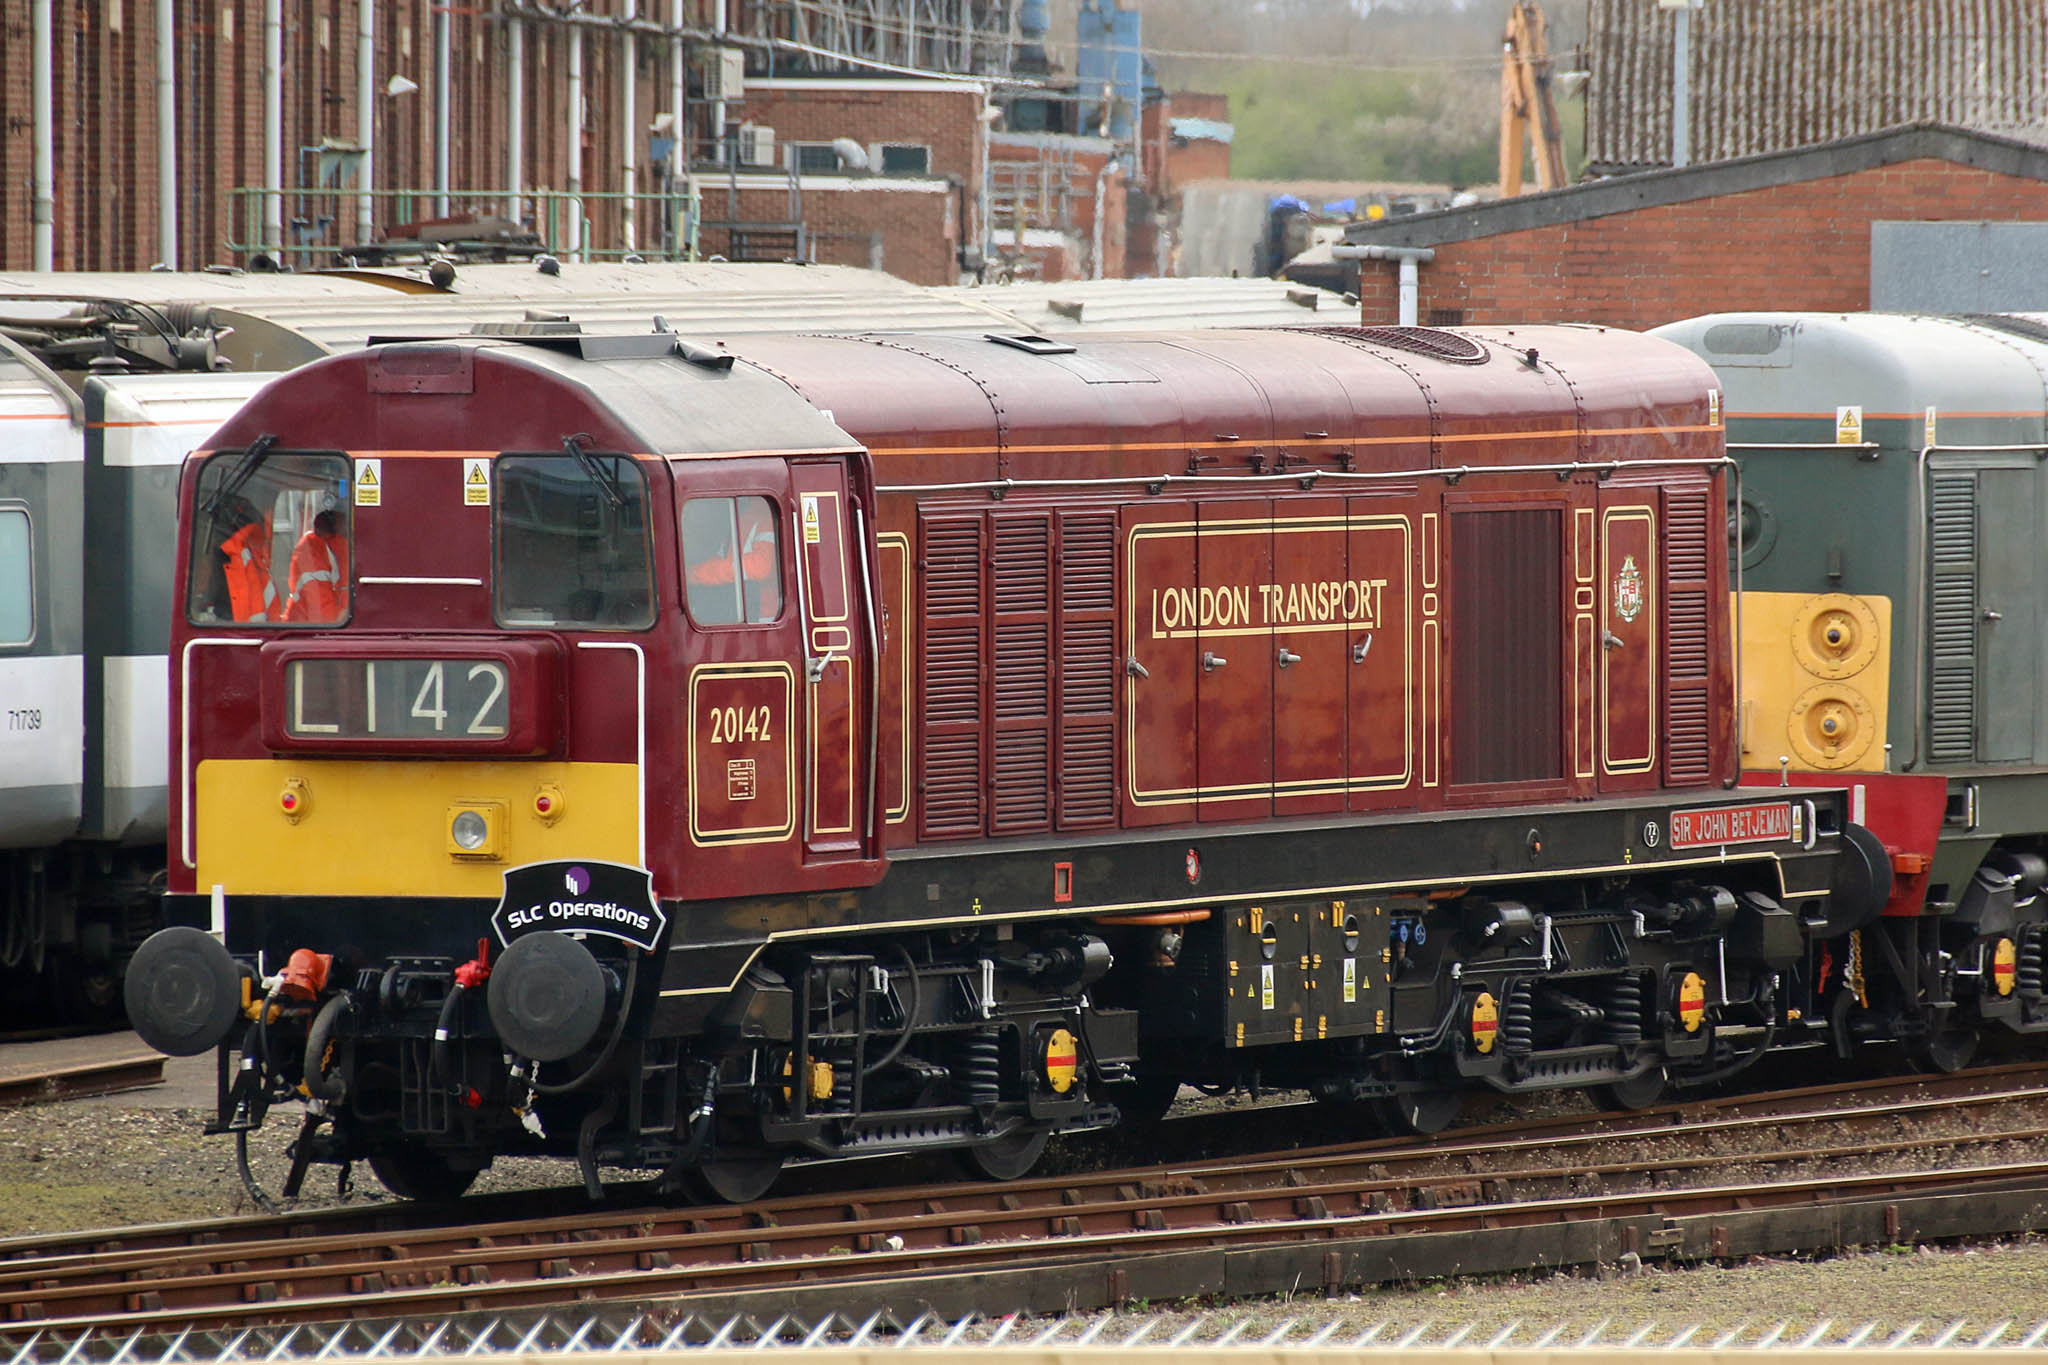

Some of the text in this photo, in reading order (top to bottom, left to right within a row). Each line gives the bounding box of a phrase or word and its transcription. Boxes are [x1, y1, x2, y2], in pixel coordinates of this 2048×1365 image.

[1152, 579, 1387, 638] LONDON TRANSPORT
[8, 709, 41, 730] 71739
[710, 705, 771, 743] 20142
[1672, 816, 1692, 842] SIR
[1695, 813, 1728, 841] JOHN
[1731, 807, 1789, 838] BETJEMAN
[507, 902, 650, 930] SLC Operations
